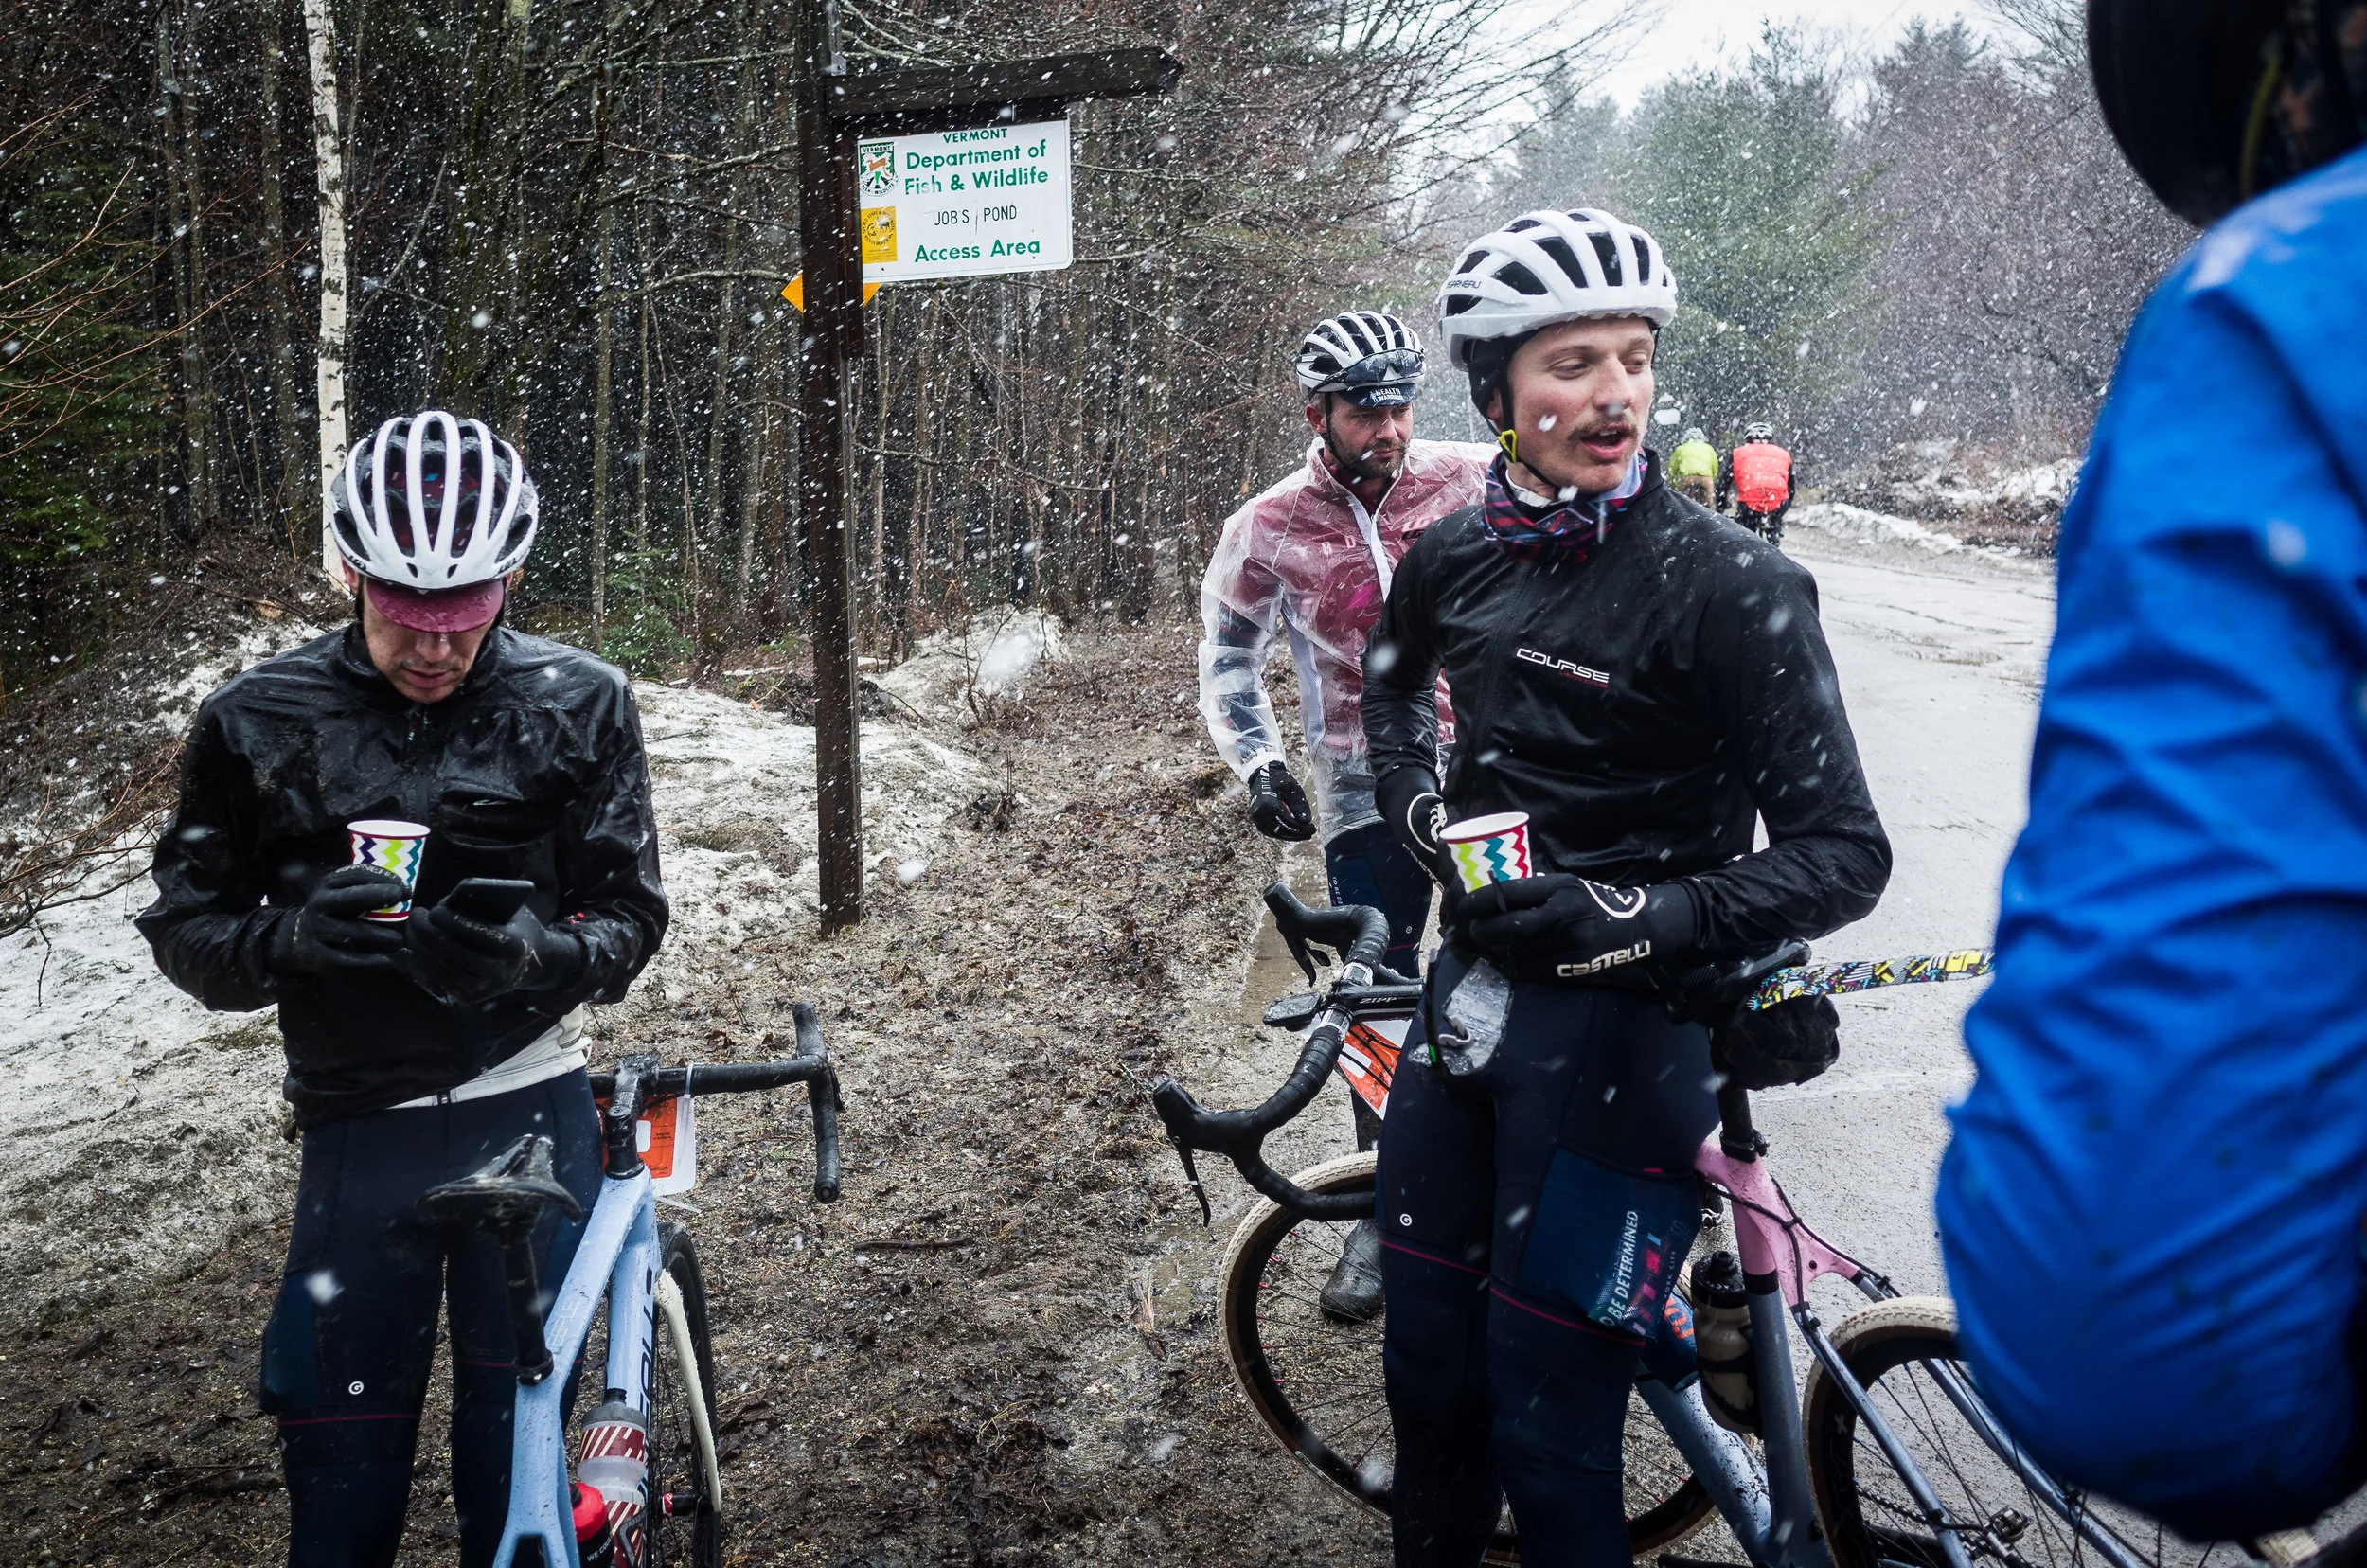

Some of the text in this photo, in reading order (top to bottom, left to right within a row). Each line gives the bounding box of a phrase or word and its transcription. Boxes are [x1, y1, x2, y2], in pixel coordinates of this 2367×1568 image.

[943, 128, 1008, 143] VERMONT
[906, 138, 1046, 171] Department of
[905, 166, 1048, 195] Fish & Wildlife
[983, 204, 1017, 222] POND
[915, 243, 981, 263] Access
[990, 239, 1041, 258] Area
[1516, 648, 1610, 684] COURSE
[1614, 1210, 1639, 1300] DETERMINED
[1607, 1297, 1627, 1320] BE
